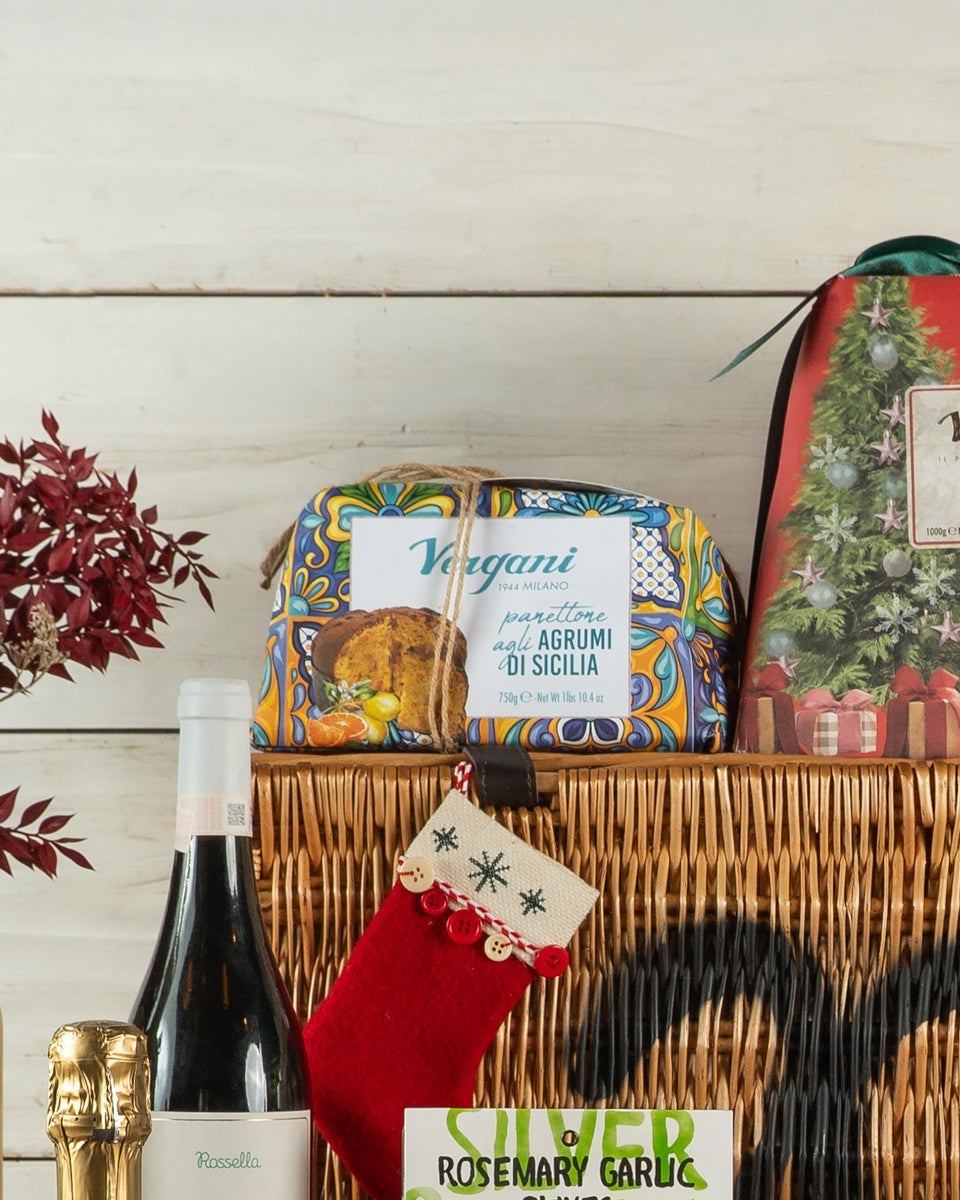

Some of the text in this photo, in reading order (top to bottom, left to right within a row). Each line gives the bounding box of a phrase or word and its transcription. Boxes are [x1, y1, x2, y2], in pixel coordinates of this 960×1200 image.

[926, 527, 947, 537] 1000g
[409, 537, 578, 594] Vergani
[498, 581, 569, 592] 1944 MILANO
[498, 602, 608, 634] panettone
[493, 624, 612, 670] agli AGRUMI
[507, 653, 599, 676] DI SICILIA
[498, 692, 518, 705] 750g
[551, 692, 560, 703] Wt
[563, 692, 576, 703] 1lbs
[580, 692, 594, 703] 10.4
[195, 1151, 262, 1169] Rossella
[446, 1108, 708, 1195] SILVER
[438, 1156, 695, 1189] ROSEMARY GARLIC
